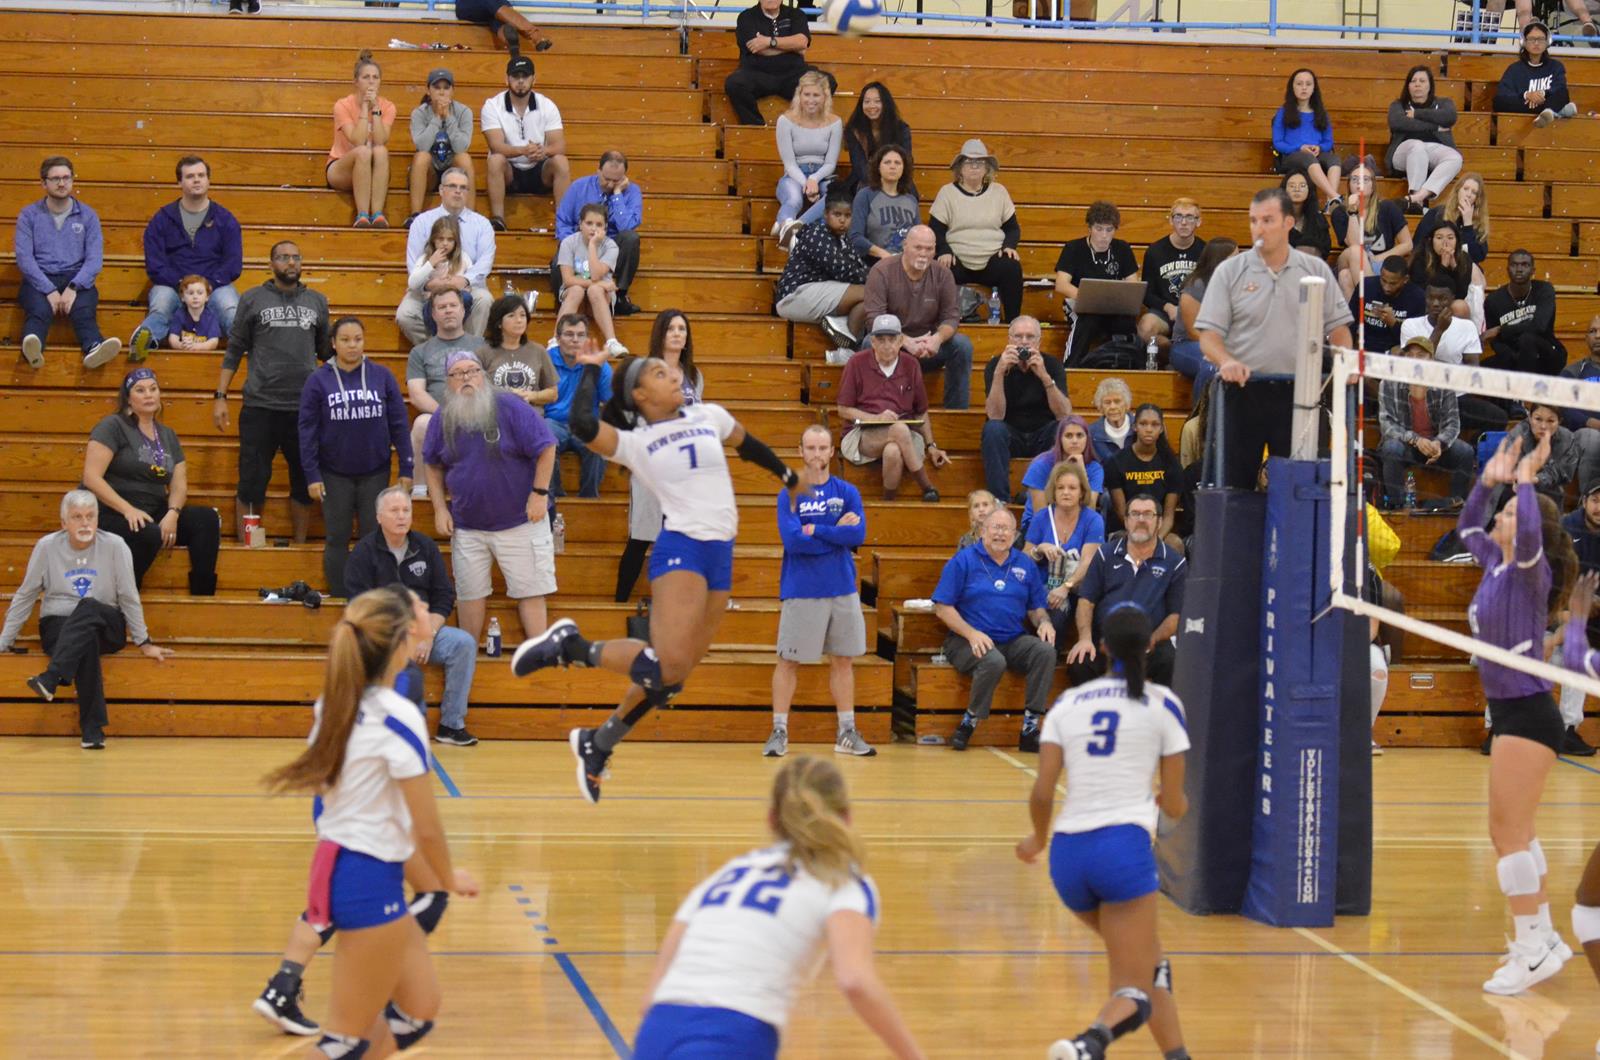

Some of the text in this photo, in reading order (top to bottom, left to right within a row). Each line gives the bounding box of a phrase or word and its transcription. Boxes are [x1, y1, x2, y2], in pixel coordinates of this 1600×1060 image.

[1528, 74, 1553, 93] NIKE
[260, 305, 318, 325] BEARS
[328, 389, 382, 407] CENTRAL
[330, 404, 383, 420] ARKANSAS
[646, 435, 669, 456] NEW
[679, 443, 698, 470] 7
[1125, 470, 1165, 481] WHISKEY
[799, 501, 827, 513] SAAC
[1262, 587, 1276, 816] PRIVATEERS
[1087, 710, 1121, 757] 3
[700, 864, 797, 916] 22
